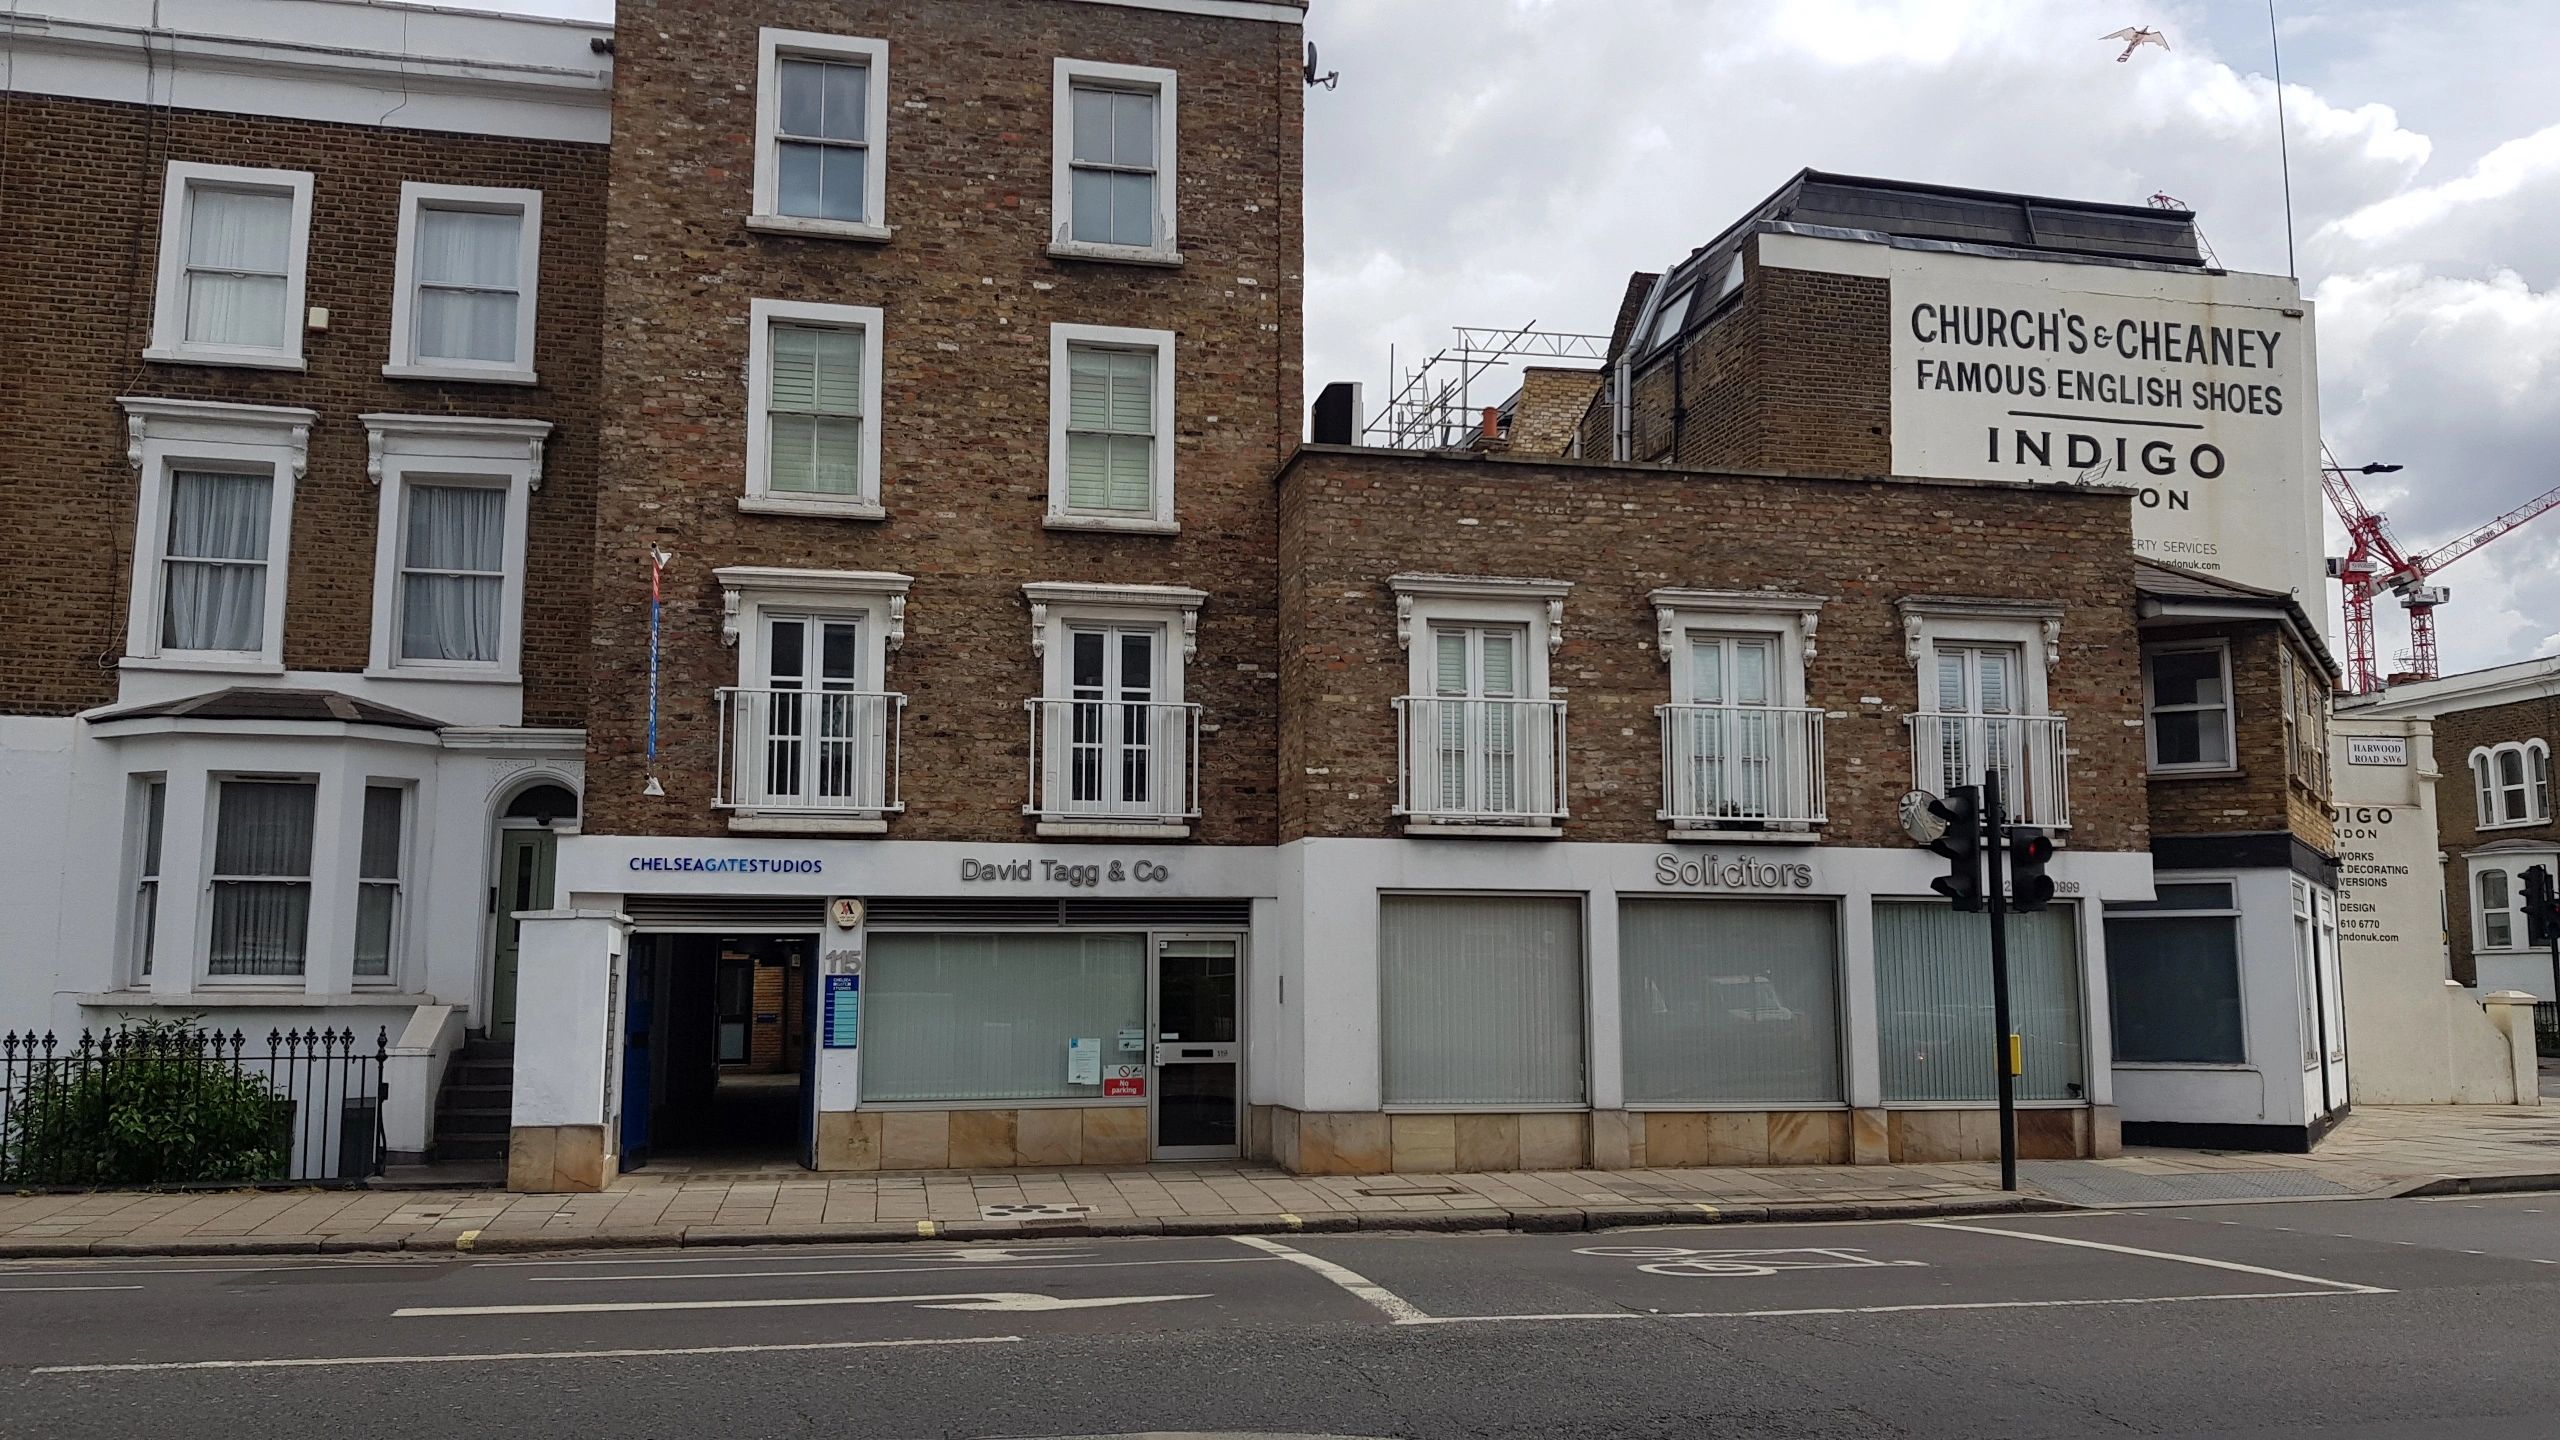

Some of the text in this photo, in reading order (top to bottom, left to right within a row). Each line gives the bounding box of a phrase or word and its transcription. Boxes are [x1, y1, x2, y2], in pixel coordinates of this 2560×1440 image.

[1911, 303, 2281, 369] CHURCH'S & CHEANEY
[1917, 359, 2283, 416] FAMOUS ENGLISH SHOES
[1988, 427, 2226, 479] INDIGO
[2163, 541, 2218, 555] SERVICES
[2353, 744, 2401, 753] HARWOOD
[2354, 755, 2402, 764] ROAD SW6
[2333, 829, 2378, 839] NDON
[2338, 852, 2375, 861] WORKS
[961, 858, 1169, 887] David Tagg & Co
[1656, 852, 1813, 888] Solicitors
[2347, 865, 2409, 875] DECORATING
[2339, 878, 2388, 888] VERSIONS
[2340, 903, 2376, 912] DESIGN
[2340, 920, 2380, 928] 610 6770
[2338, 932, 2399, 942] ondonuk.com
[826, 950, 862, 974] 115
[1111, 1087, 1137, 1096] parking
